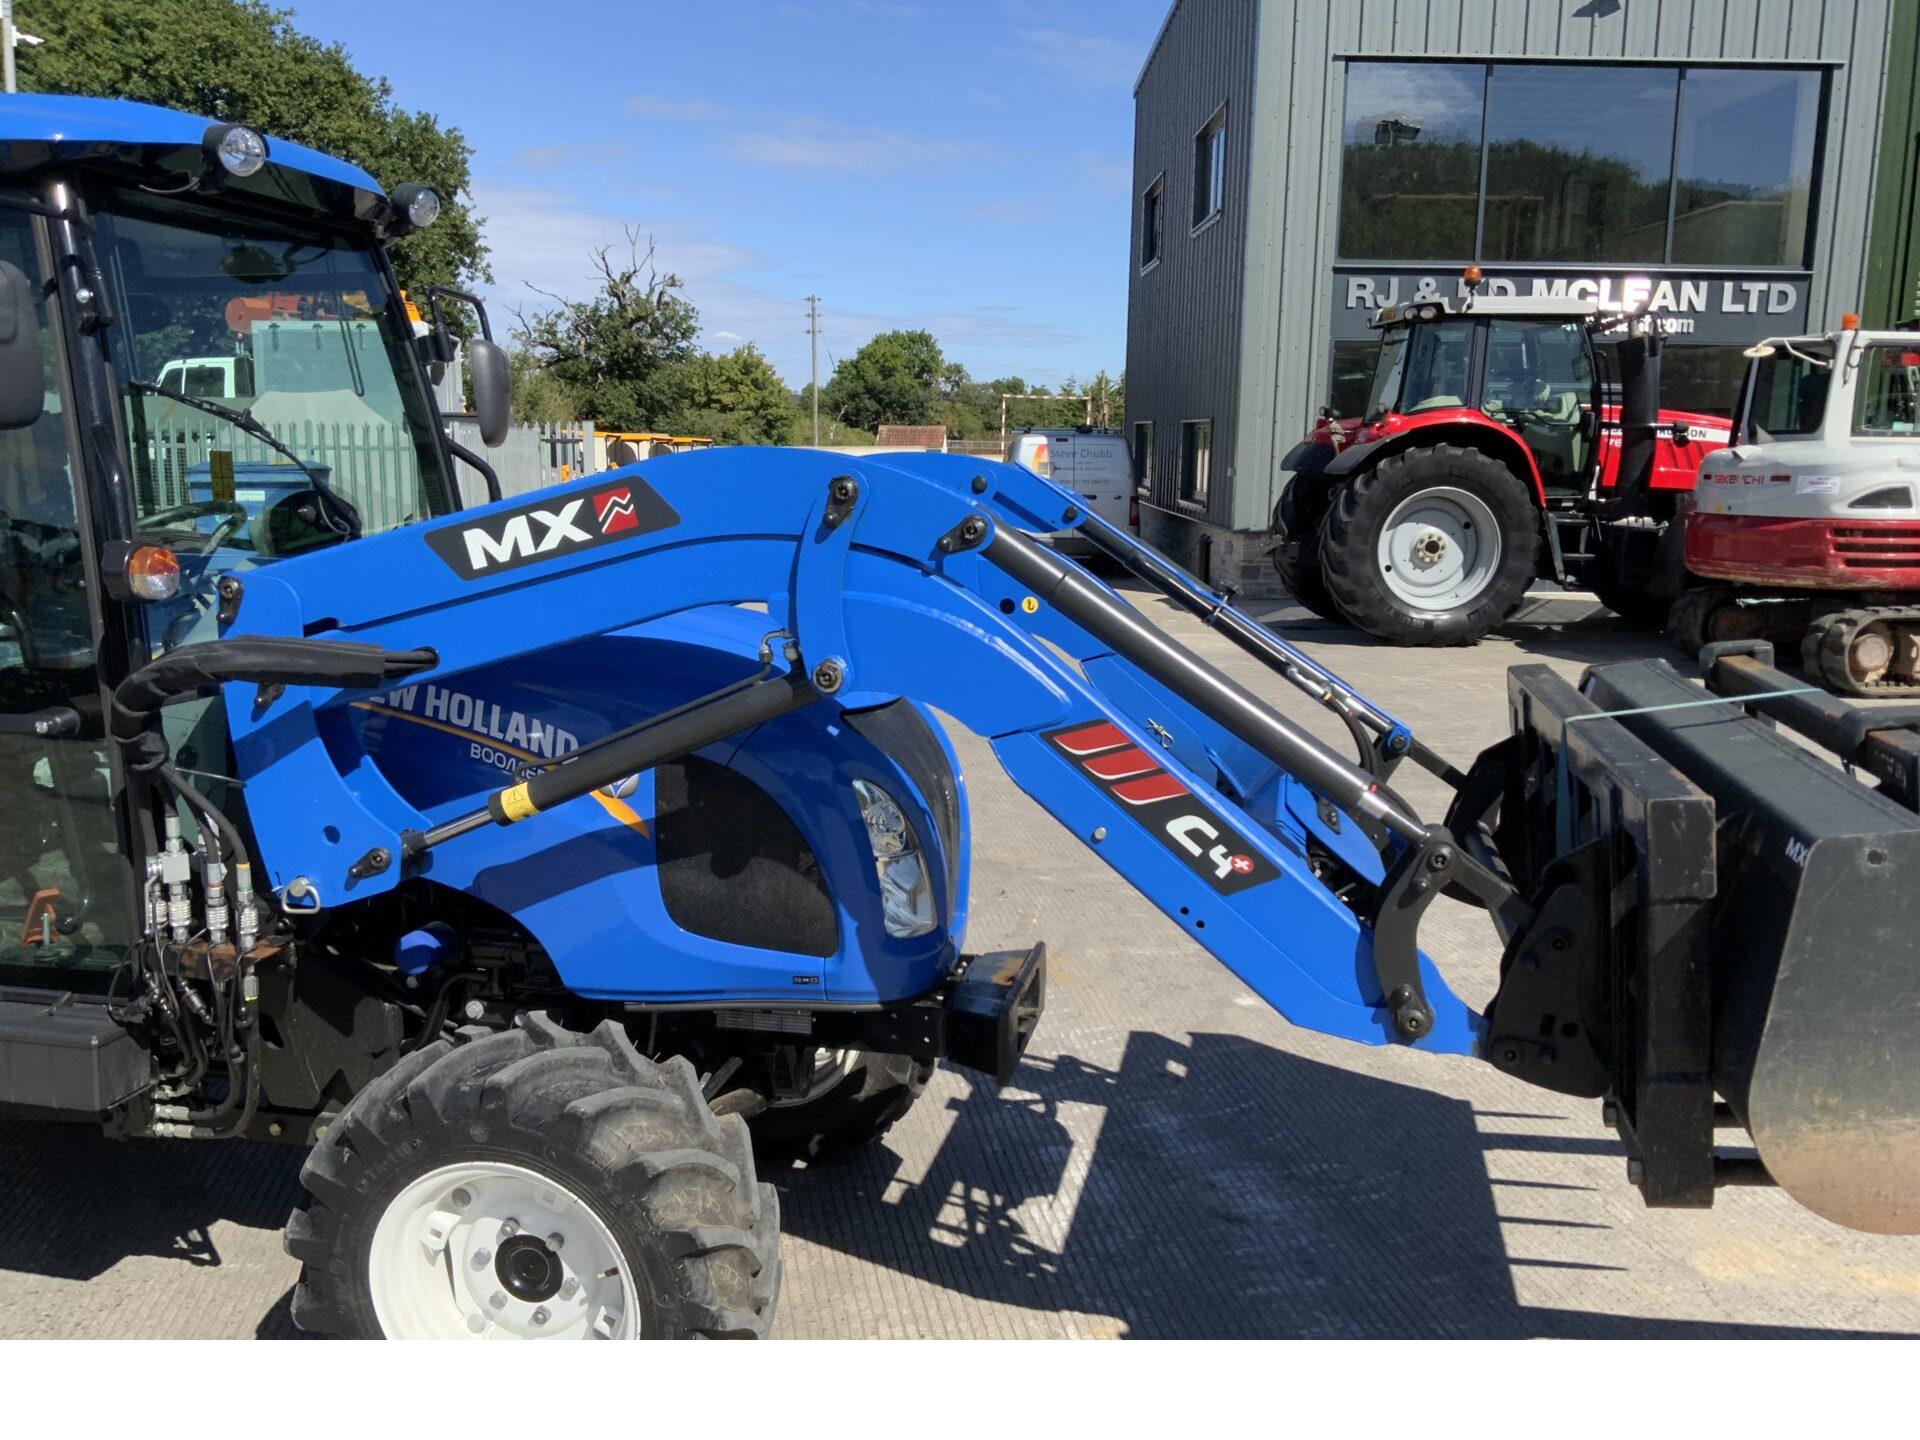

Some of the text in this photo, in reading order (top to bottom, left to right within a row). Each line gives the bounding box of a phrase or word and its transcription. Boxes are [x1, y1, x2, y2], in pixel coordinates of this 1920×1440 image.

[1347, 277, 1399, 308] RJ
[1721, 281, 1797, 313] LTD
[1050, 448, 1113, 459] Steve Chubb
[462, 498, 594, 570] MX
[425, 684, 580, 765] HOLLAND
[1785, 837, 1809, 866] MX
